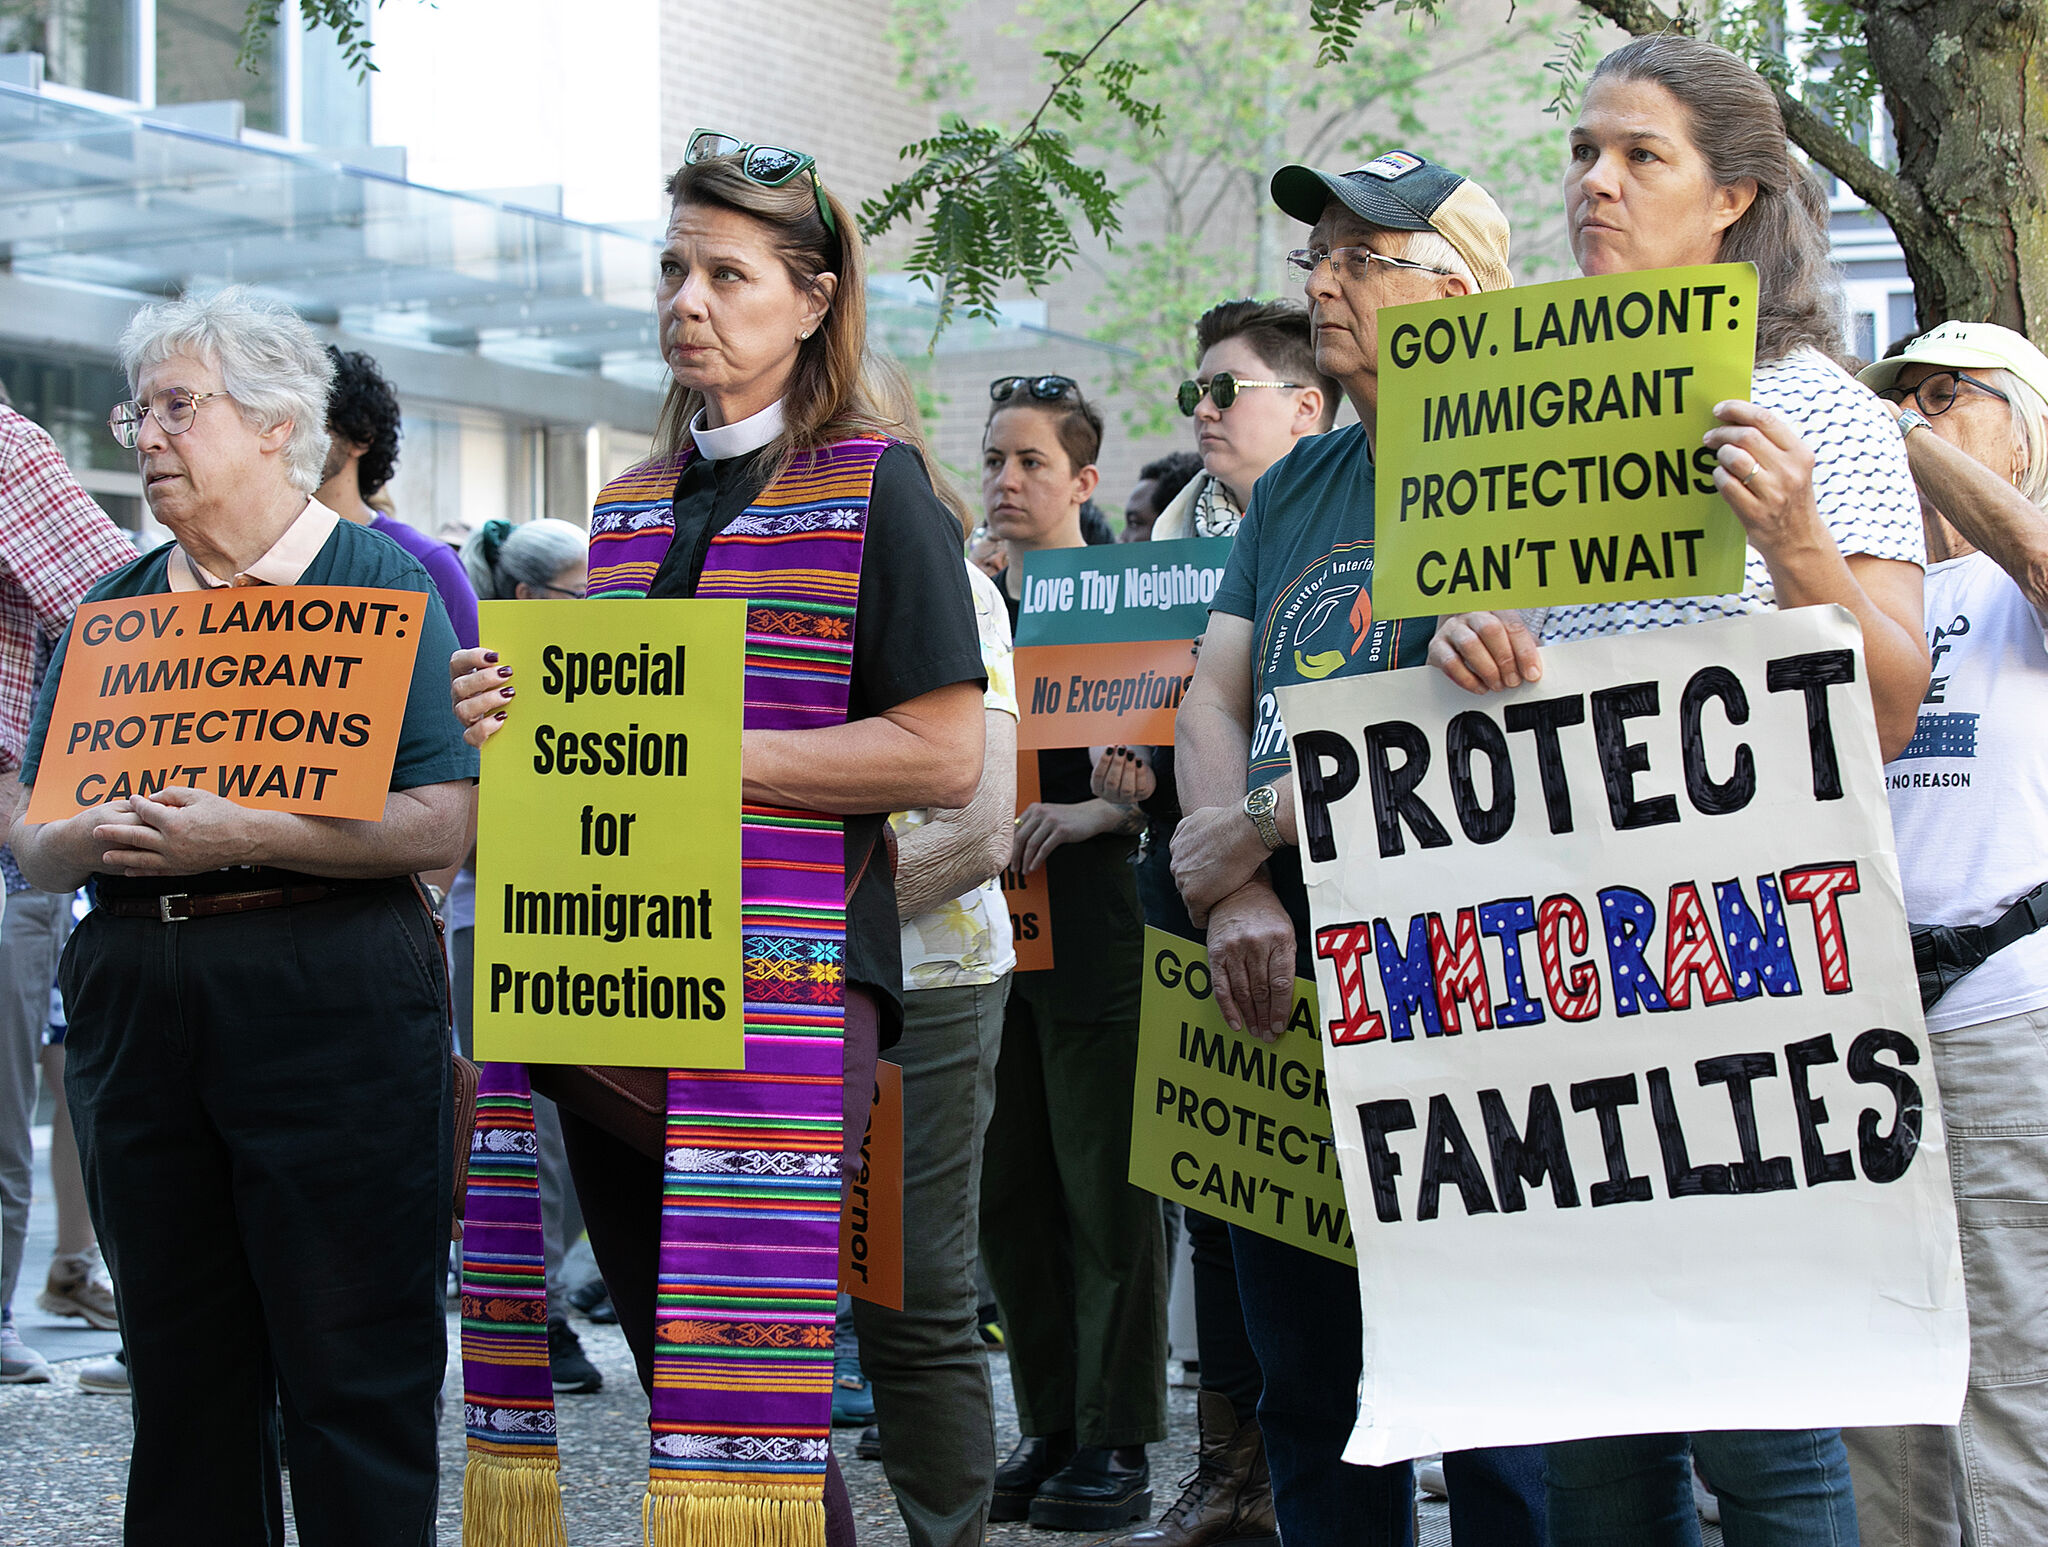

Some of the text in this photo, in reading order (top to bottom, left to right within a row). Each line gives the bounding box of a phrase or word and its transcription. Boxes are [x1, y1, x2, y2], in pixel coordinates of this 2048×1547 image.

[1390, 285, 1740, 369] GOV. LAMONT:
[1423, 366, 1694, 443] IMMIGRANT
[1400, 446, 1719, 522] PROTECTIONS
[1023, 575, 1075, 614] Love
[1080, 569, 1120, 615] Thy
[1416, 529, 1704, 597] CAN'T WAIT
[82, 600, 409, 646] GOV. LAMONT:
[99, 654, 362, 698] IMMIGRANT
[541, 643, 686, 703] Special
[1031, 676, 1062, 715] No
[66, 708, 371, 755] PROTECTIONS
[533, 723, 688, 777] Session
[1291, 648, 1856, 863] PROTECT
[75, 764, 337, 807] CAN'T WAIT
[1892, 774, 1910, 789] NO
[1913, 773, 1970, 788] REASON
[580, 805, 636, 856] for
[503, 883, 712, 943] Immigrant
[1316, 860, 1860, 1047] IMMIGRANT
[490, 963, 726, 1021] Protections
[1179, 1022, 1330, 1111] IMMIGR
[1156, 1077, 1341, 1179] PROTECT
[1357, 1028, 1923, 1223] FAMILIES
[1171, 1151, 1294, 1225] CAN'T
